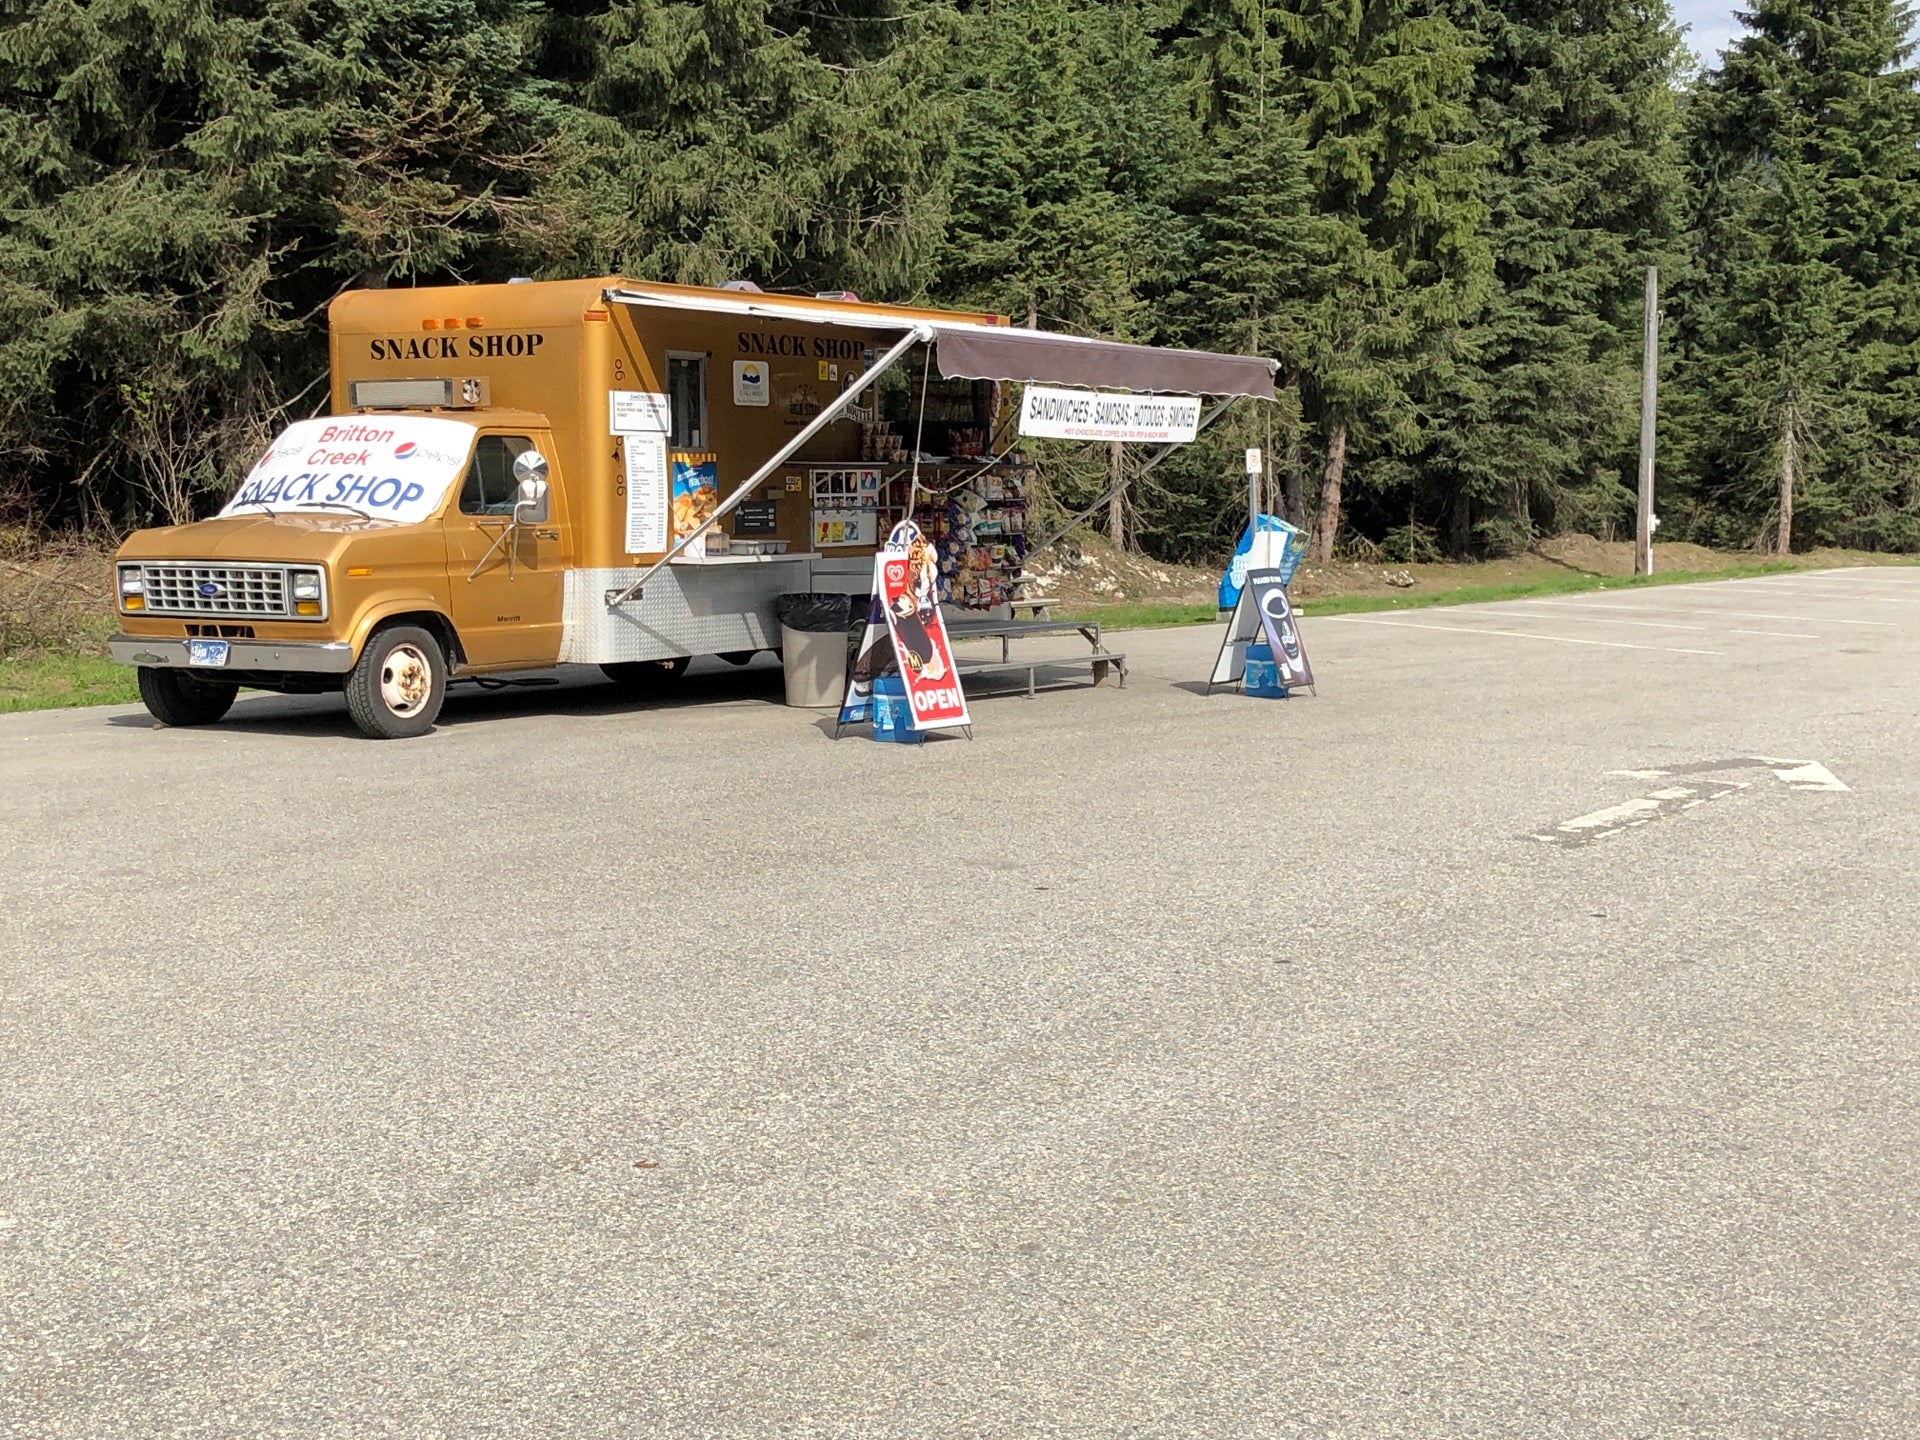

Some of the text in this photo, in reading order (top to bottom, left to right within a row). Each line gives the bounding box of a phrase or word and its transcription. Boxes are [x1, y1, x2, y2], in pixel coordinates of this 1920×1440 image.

[370, 333, 544, 360] SNACK SHOP
[737, 331, 865, 360] SNACK SHOP
[1029, 396, 1090, 424] SANDWICHES
[1094, 401, 1130, 427] SAMOSAS
[1132, 403, 1166, 428] HOTDOGS
[1167, 405, 1196, 428] SMOKIES
[318, 425, 395, 443] Britton
[307, 449, 373, 466] Creek
[414, 447, 463, 467] pepsi
[232, 473, 425, 511] SNACK SHOP
[913, 687, 961, 712] OPEN
